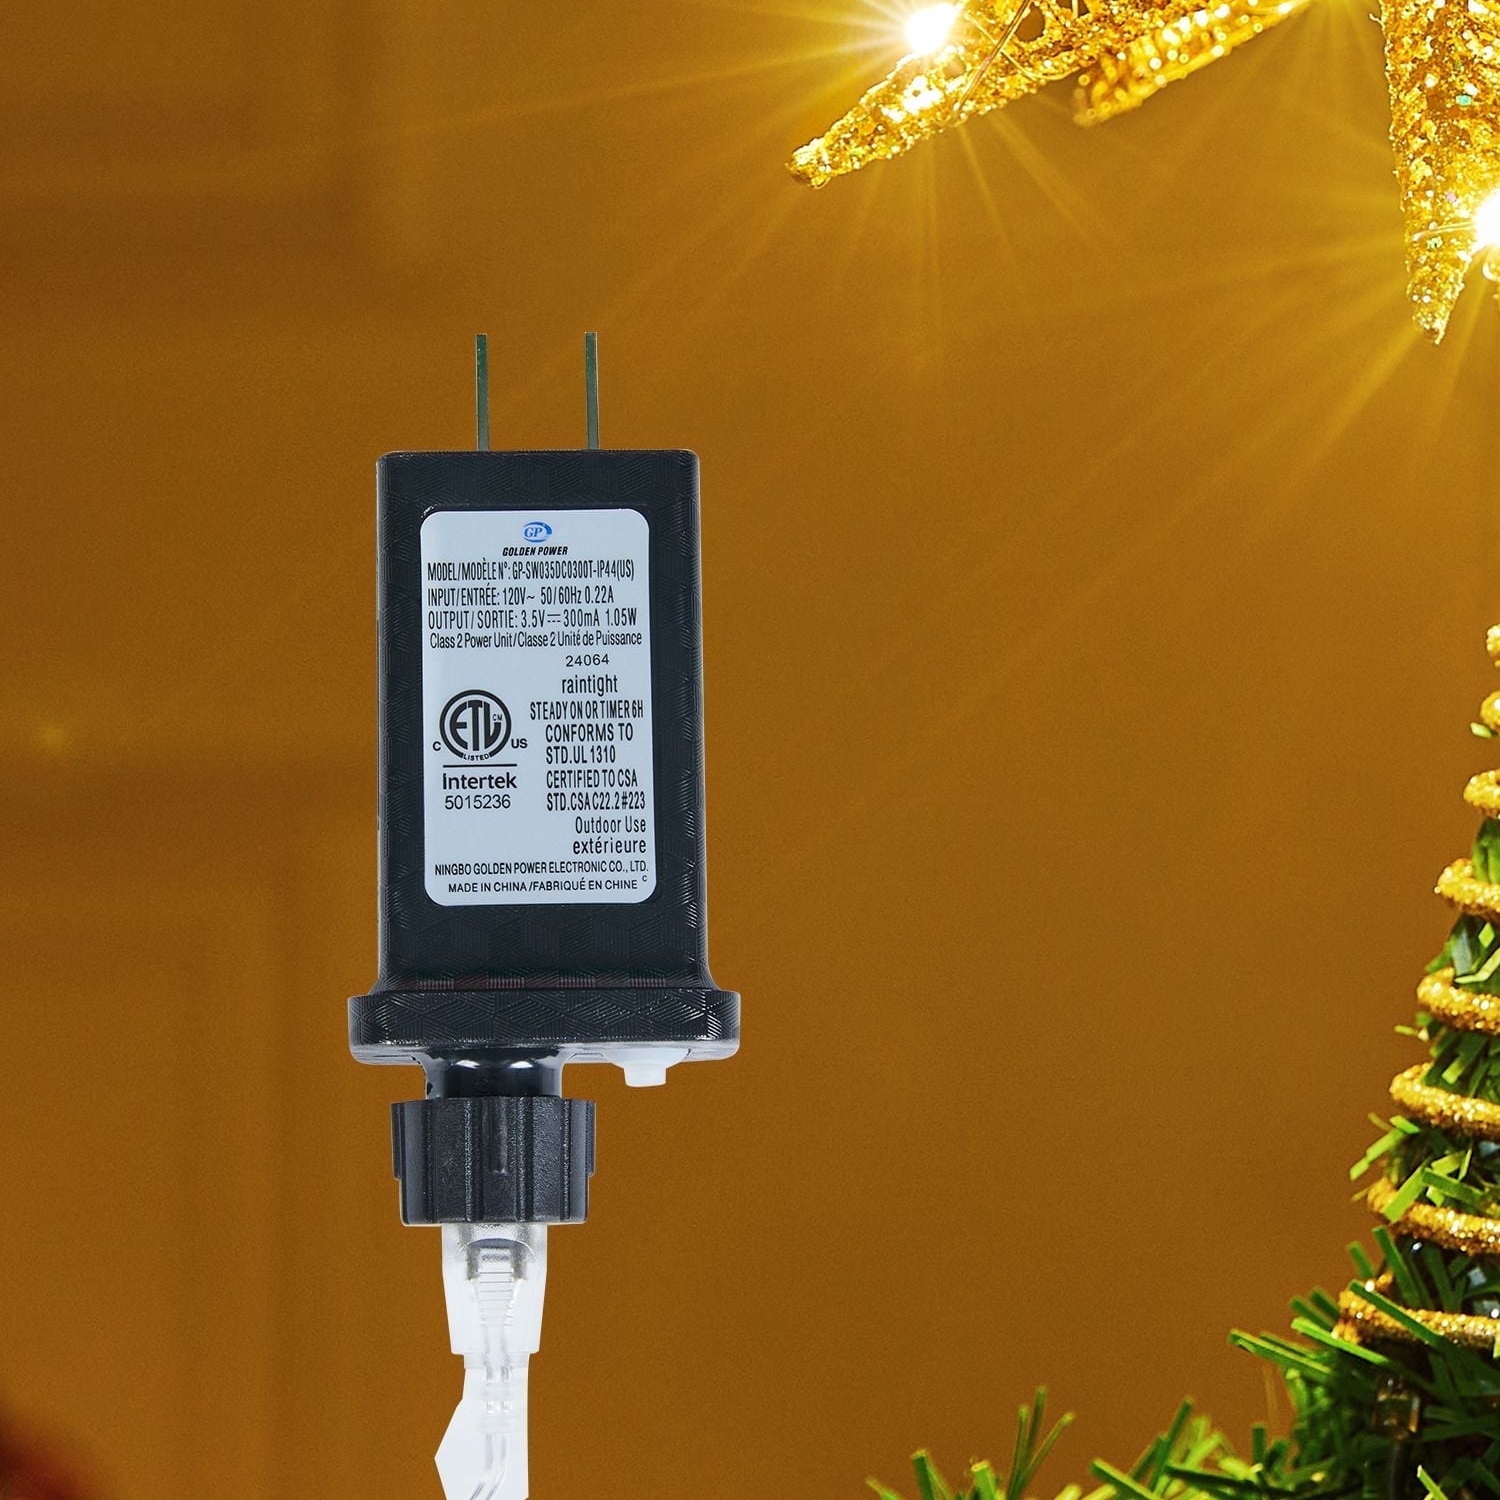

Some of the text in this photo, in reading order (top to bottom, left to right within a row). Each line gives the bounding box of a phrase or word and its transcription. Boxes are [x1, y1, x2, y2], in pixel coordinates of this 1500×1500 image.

[524, 527, 543, 538] GP
[502, 547, 568, 556] GOLDEN POWER
[428, 583, 500, 606] INPUT/ENTRÉE:
[540, 586, 582, 604] 50/60Hz
[584, 585, 614, 603] 0.22A
[605, 607, 637, 626] 1.05W
[430, 629, 642, 648] Class 2 Power Unit/Classe 2 Unité de Puissance
[565, 654, 609, 667] 24064
[562, 675, 618, 697] raintight
[530, 700, 644, 720] STEADY ON OR TIMER 6H
[545, 723, 633, 742] CONFORMS TO
[511, 738, 528, 749] US
[462, 753, 489, 761] LISTED
[590, 745, 616, 763] 1310
[443, 772, 517, 790] Intertek
[546, 769, 638, 789] CERTIFIED TO CSA
[445, 794, 511, 810] 5015236
[575, 816, 646, 833] Outdoor Use
[573, 837, 646, 854] extérieure
[435, 863, 472, 875] NINGBO
[473, 863, 512, 875] GOLDEN
[514, 863, 547, 874] POWER
[549, 861, 607, 874] ELECTRONIC
[630, 861, 648, 872] LTD.
[448, 883, 478, 893] MADE
[480, 883, 492, 892] IN
[493, 882, 526, 892] CHINA
[588, 881, 602, 890] EN
[605, 880, 637, 889] CHINE
